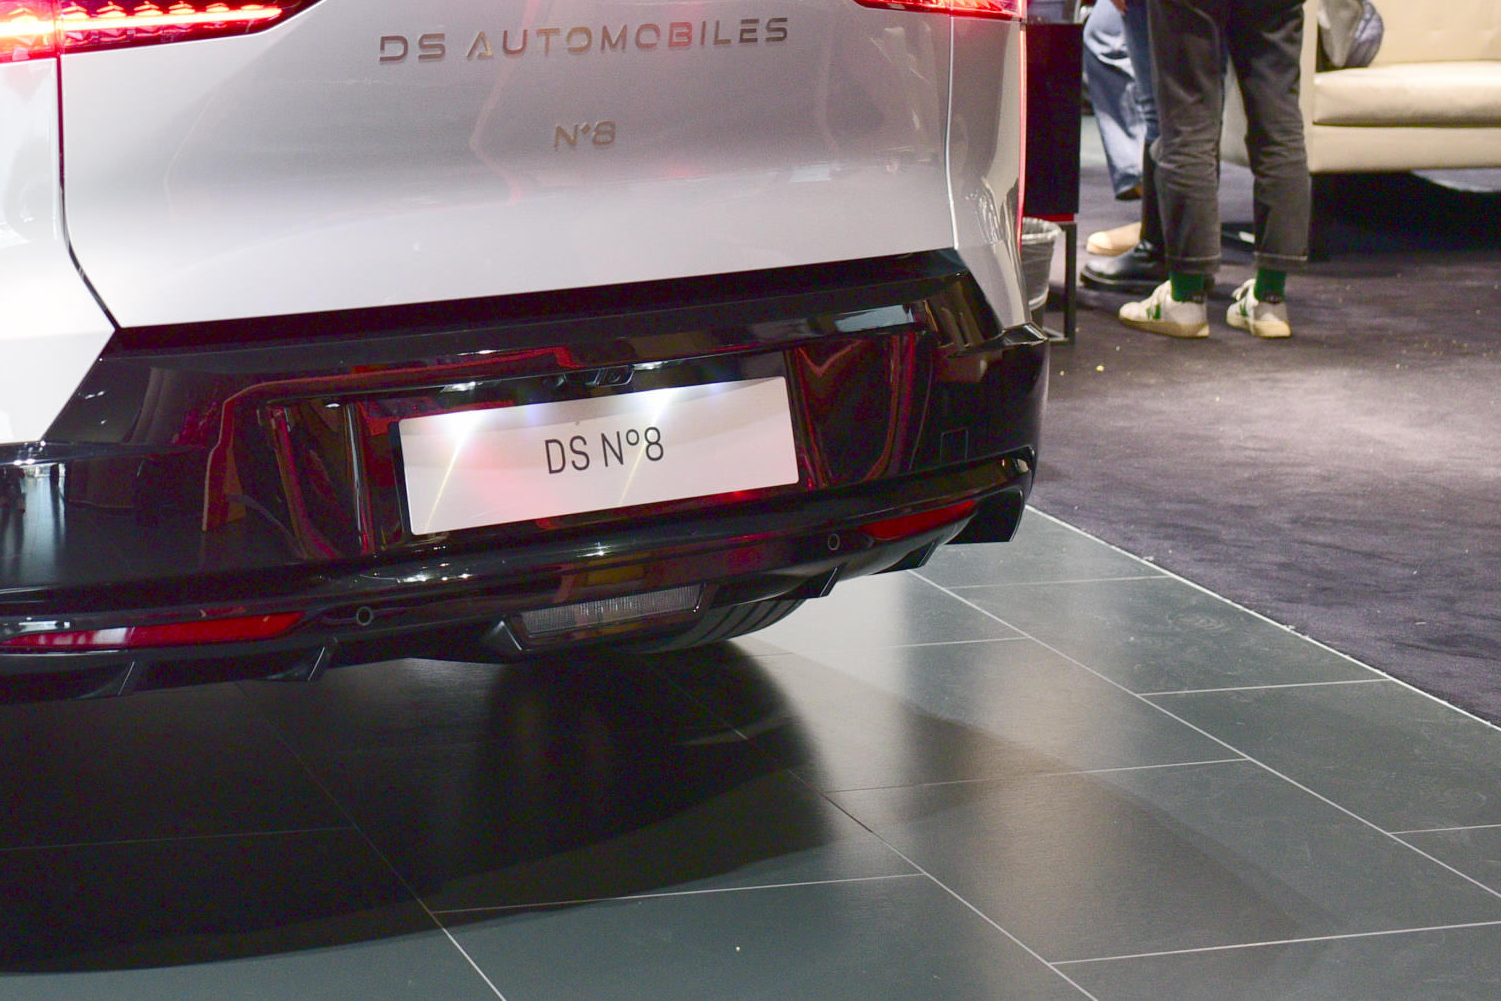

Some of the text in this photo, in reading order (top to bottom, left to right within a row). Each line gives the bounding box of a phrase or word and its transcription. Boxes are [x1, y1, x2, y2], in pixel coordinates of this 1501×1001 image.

[379, 17, 788, 61] DS AUTOMOBILES
[545, 435, 590, 474] DS
